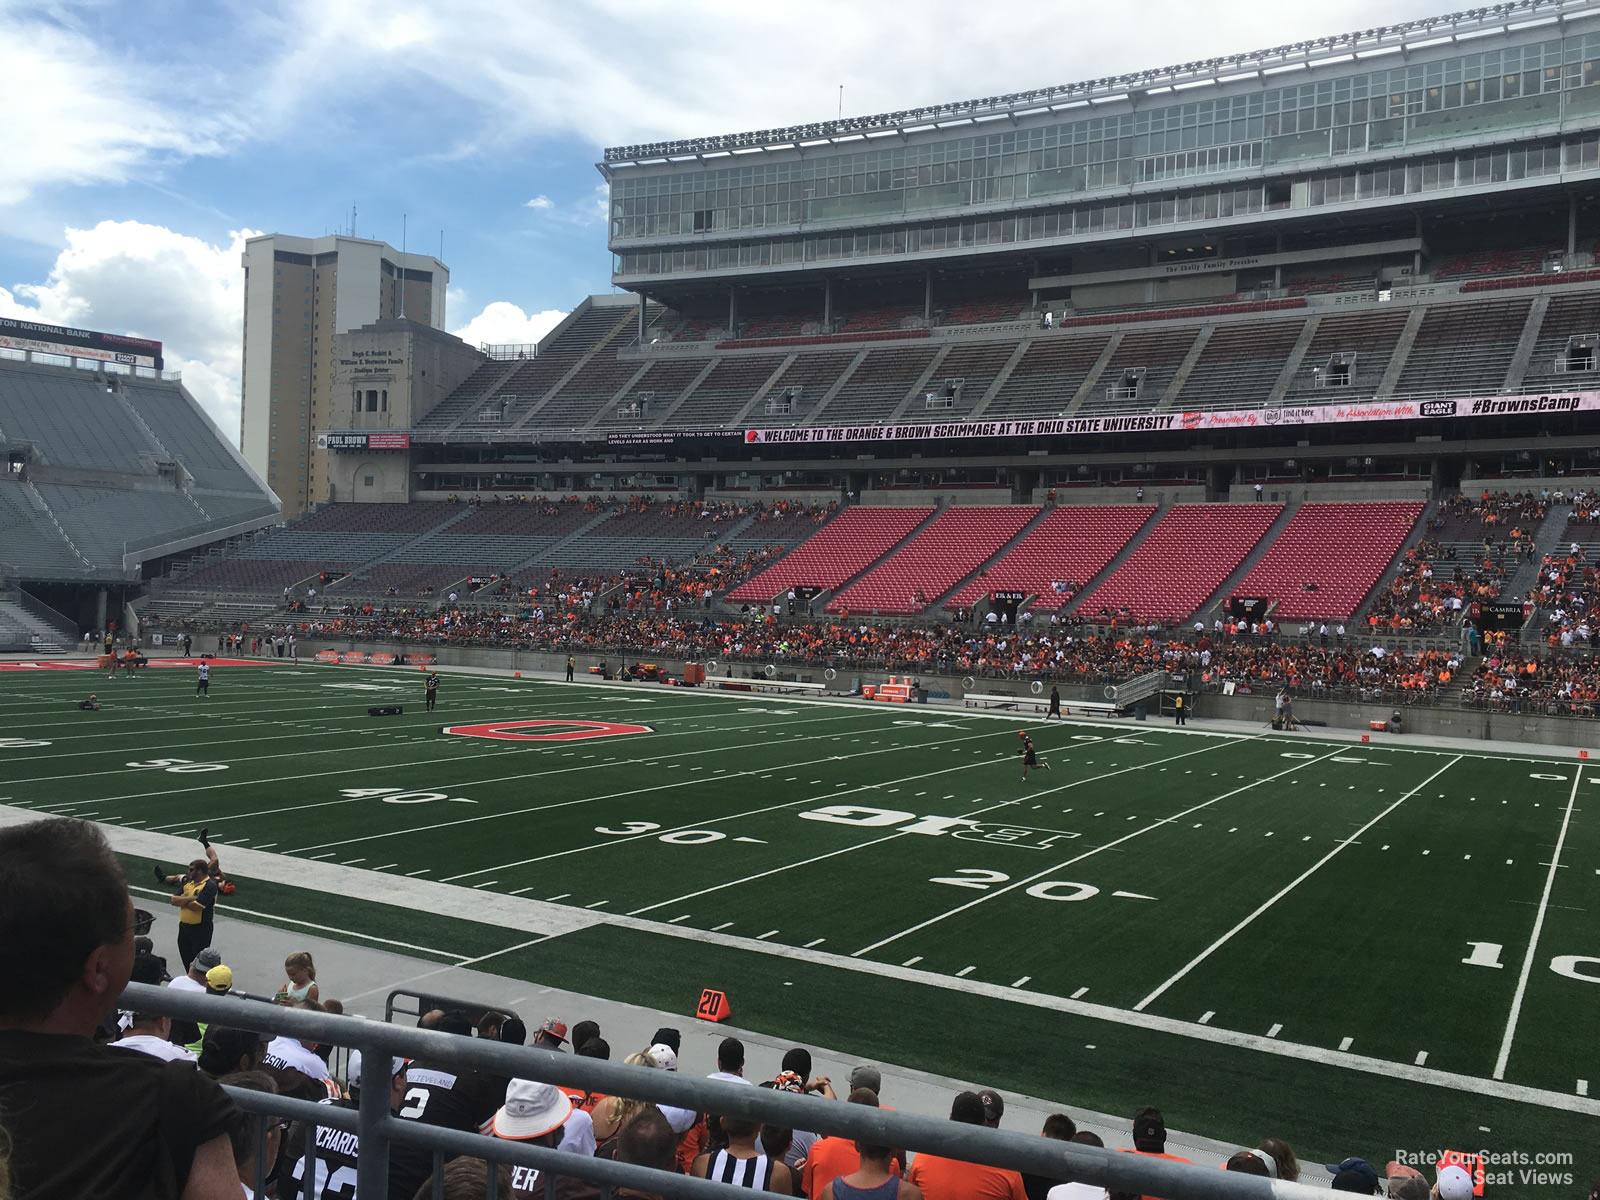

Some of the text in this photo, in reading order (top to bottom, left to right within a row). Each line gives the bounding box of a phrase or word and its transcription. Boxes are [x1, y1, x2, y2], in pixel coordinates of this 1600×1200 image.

[1204, 262, 1226, 270] Family
[20, 322, 64, 335] NATIONAL
[66, 329, 91, 339] BANK
[1346, 407, 1392, 417] Association
[1472, 396, 1580, 414] #BrownsCamp
[764, 430, 809, 442] WELCOME
[812, 430, 823, 441] TO
[826, 429, 843, 440] THE
[846, 427, 883, 440] ORANGE
[886, 427, 893, 438] &
[895, 425, 932, 438] BROWN
[934, 423, 996, 437] SCRIMMAGE
[998, 423, 1012, 435] AT
[1015, 422, 1034, 434] THE
[1037, 421, 1064, 433] OHIO
[1066, 419, 1100, 432] STATE
[1103, 416, 1174, 431] UNIVERSITY
[327, 436, 343, 445] PAUL
[344, 436, 367, 445] BROWN
[125, 758, 230, 773] 50
[338, 787, 449, 804] 40
[594, 821, 727, 845] 30
[928, 868, 1101, 901] 20
[1461, 941, 1600, 984] 10
[699, 990, 722, 1016] 20
[400, 1088, 431, 1120] 2
